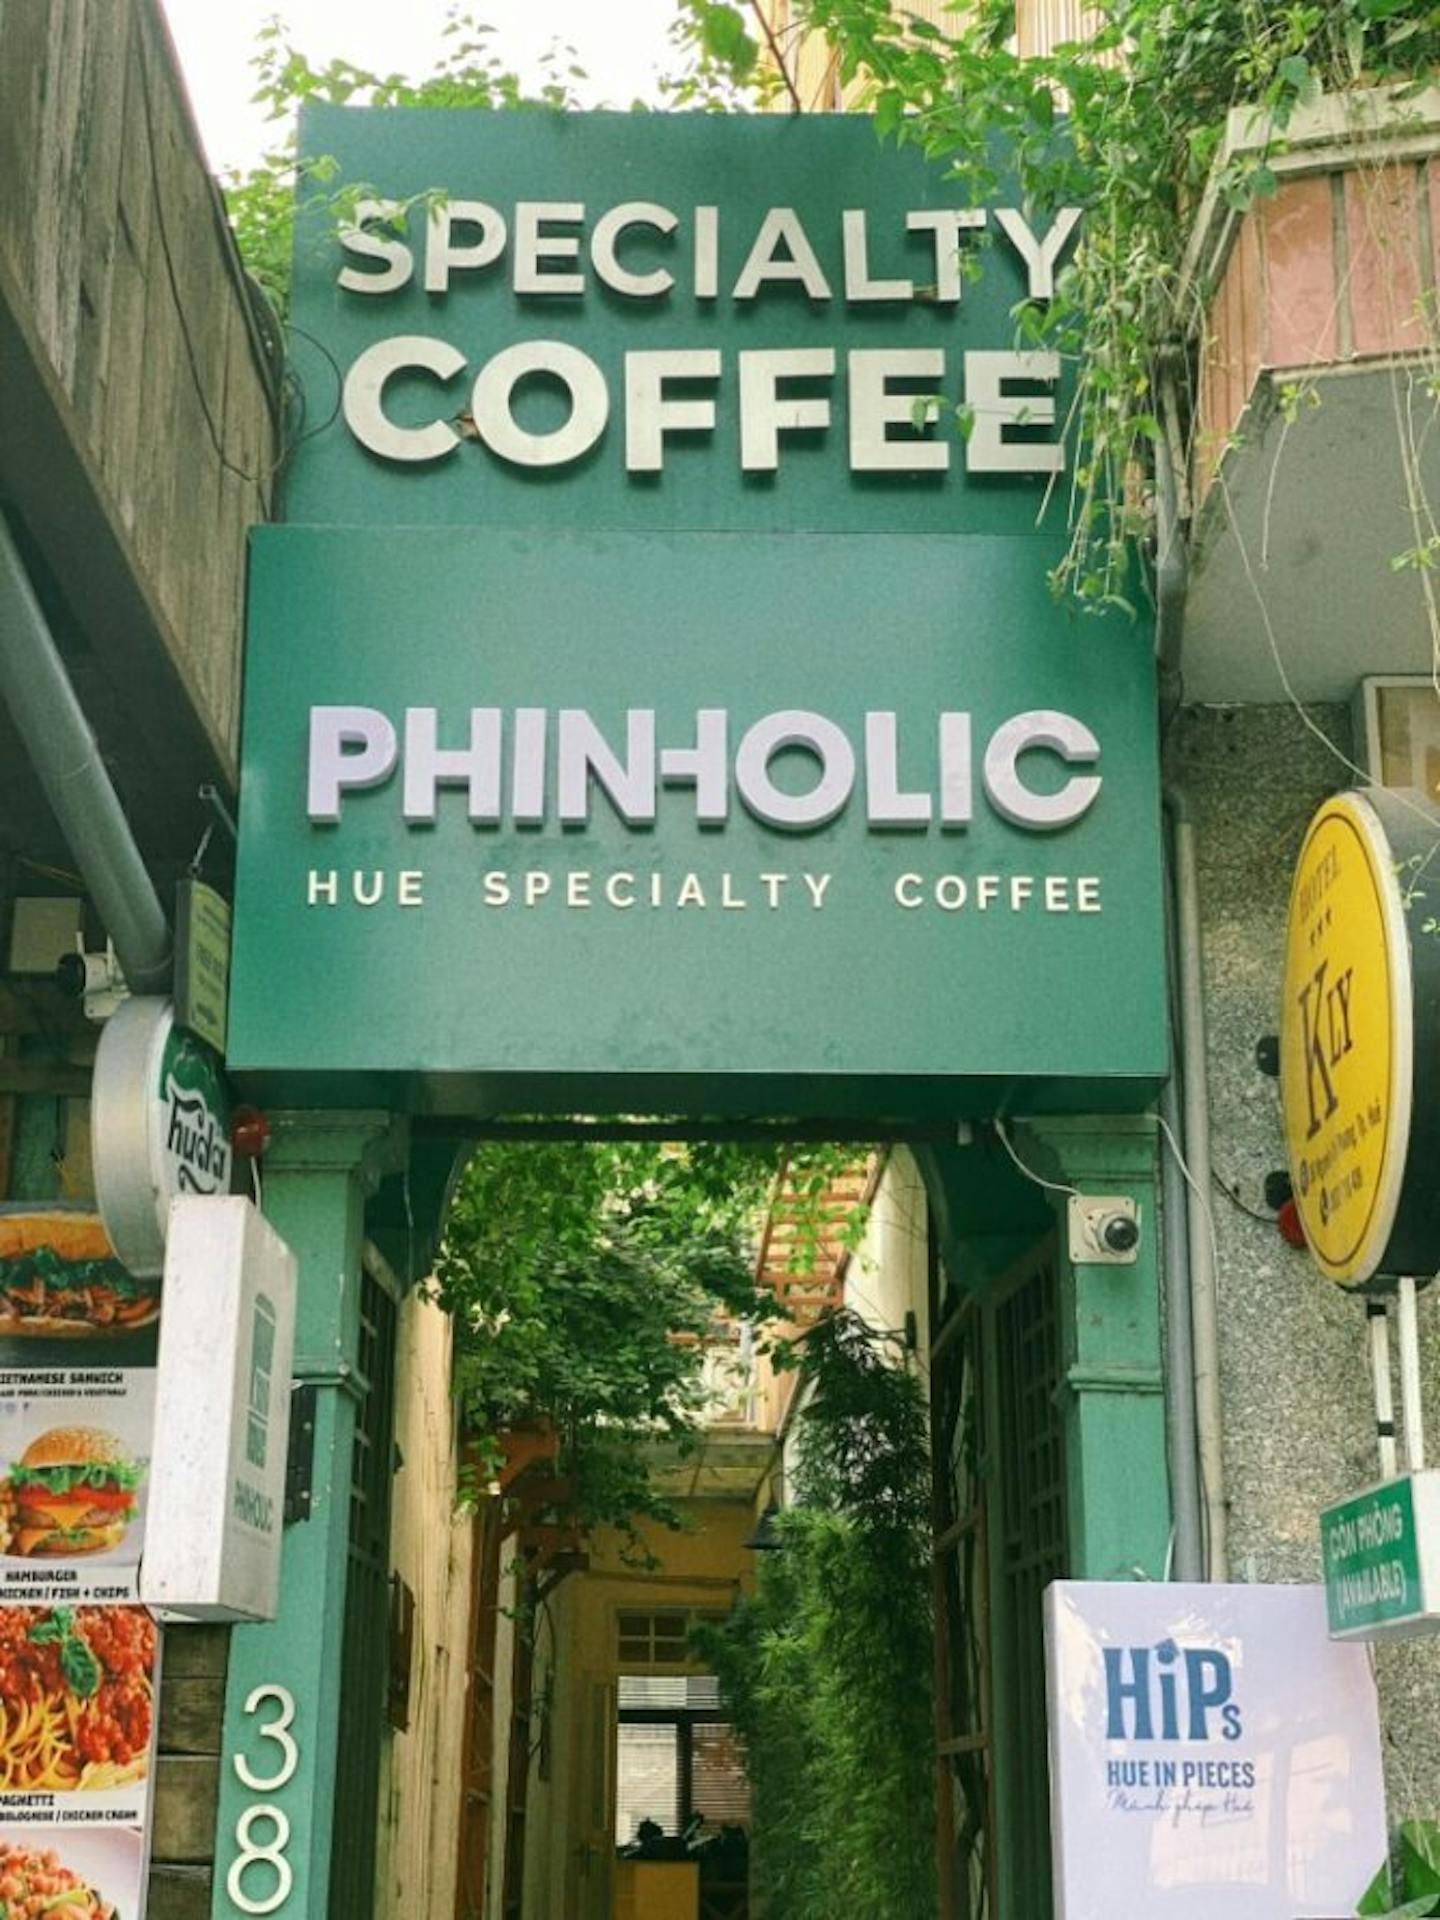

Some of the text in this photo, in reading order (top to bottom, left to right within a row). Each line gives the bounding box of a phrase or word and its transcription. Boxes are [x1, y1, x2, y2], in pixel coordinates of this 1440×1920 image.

[336, 200, 1082, 303] SPECIALTY
[343, 335, 1066, 472] COFFEE
[307, 869, 1102, 913] HUE SPECIALTY COFFEE
[0, 1373, 65, 1385] IETNAMESE
[93, 1586, 130, 1598] CHIPS
[1108, 1761, 1255, 1788] HUE IN PIECES
